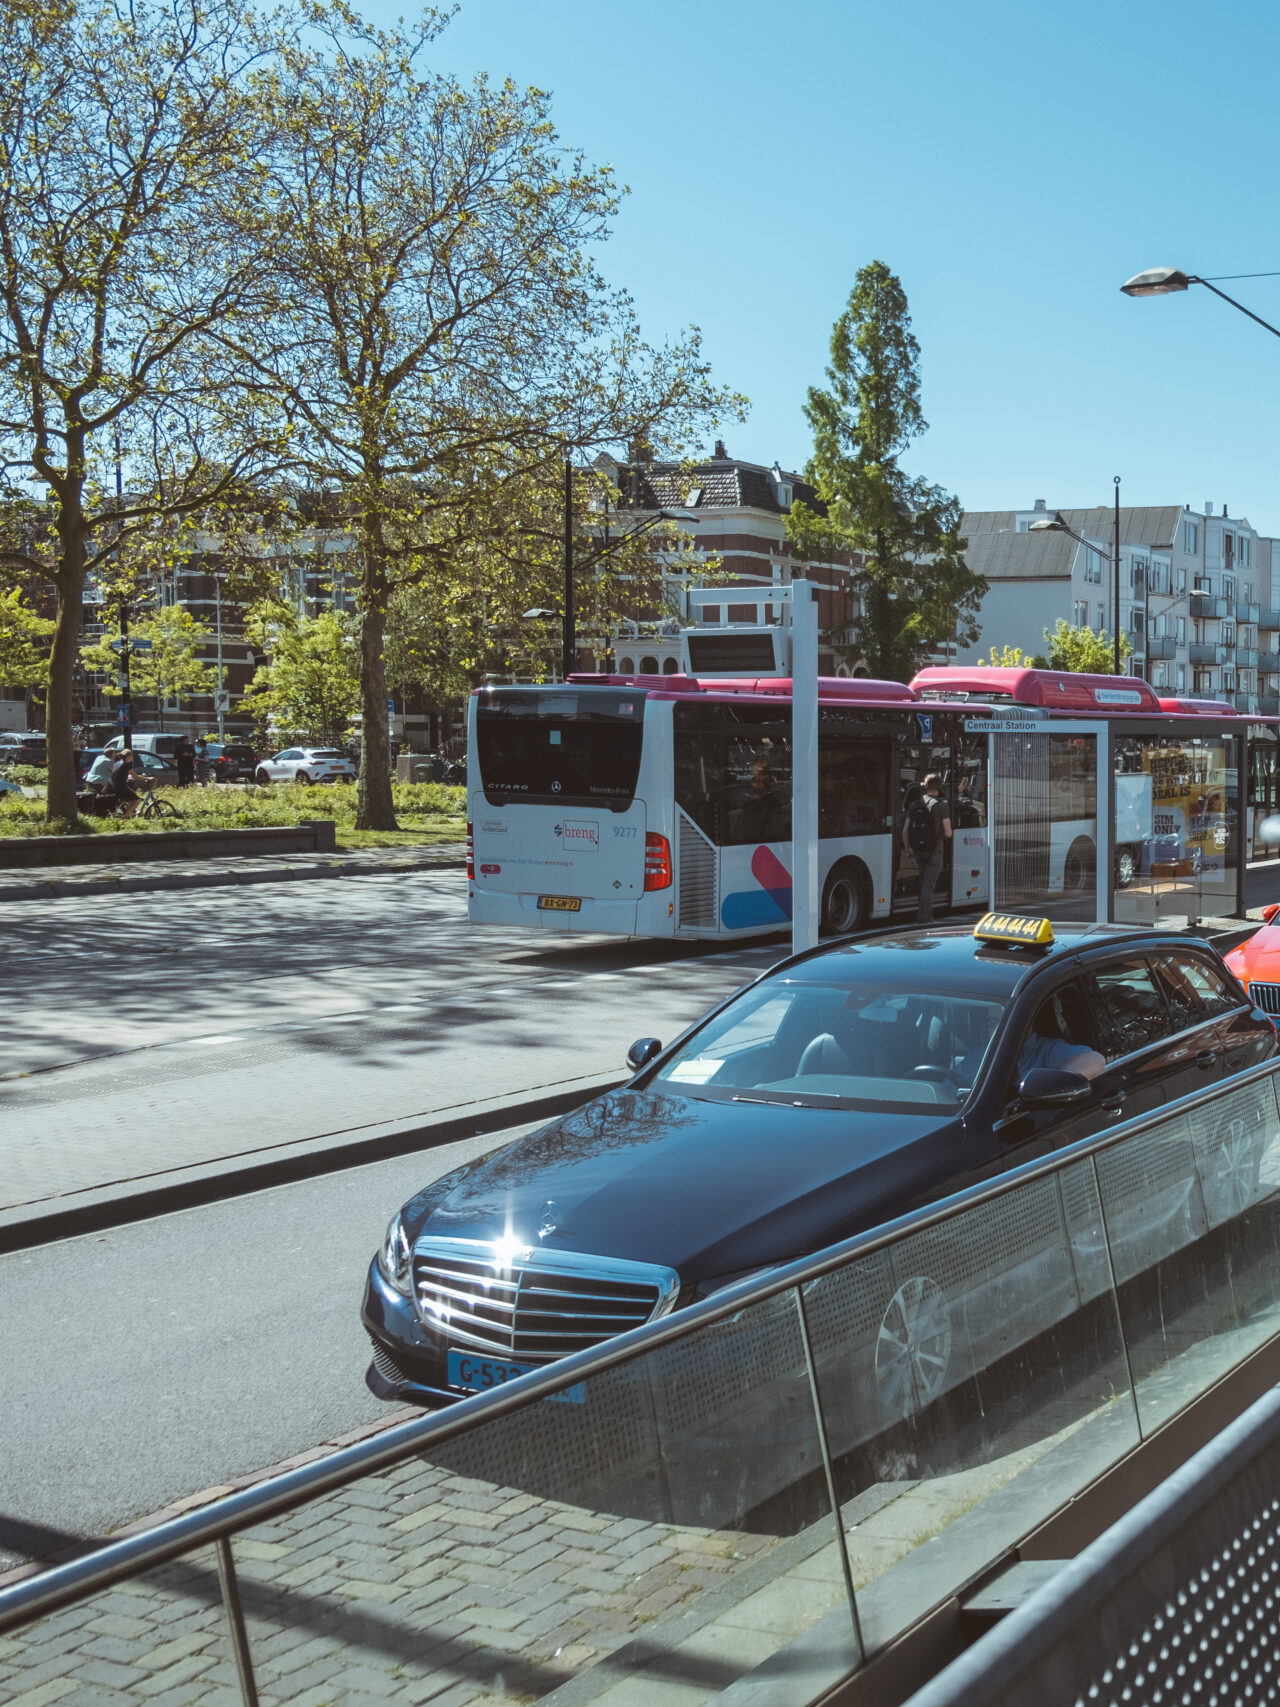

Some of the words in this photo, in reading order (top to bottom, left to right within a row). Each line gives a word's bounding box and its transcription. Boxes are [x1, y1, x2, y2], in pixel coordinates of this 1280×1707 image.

[967, 721, 1003, 730] Centraal
[1005, 721, 1036, 730] Station
[1180, 786, 1191, 797] IS
[1154, 815, 1174, 824] SIM
[564, 825, 595, 842] breng
[613, 826, 638, 838] 9277
[1154, 825, 1181, 835] ONLY
